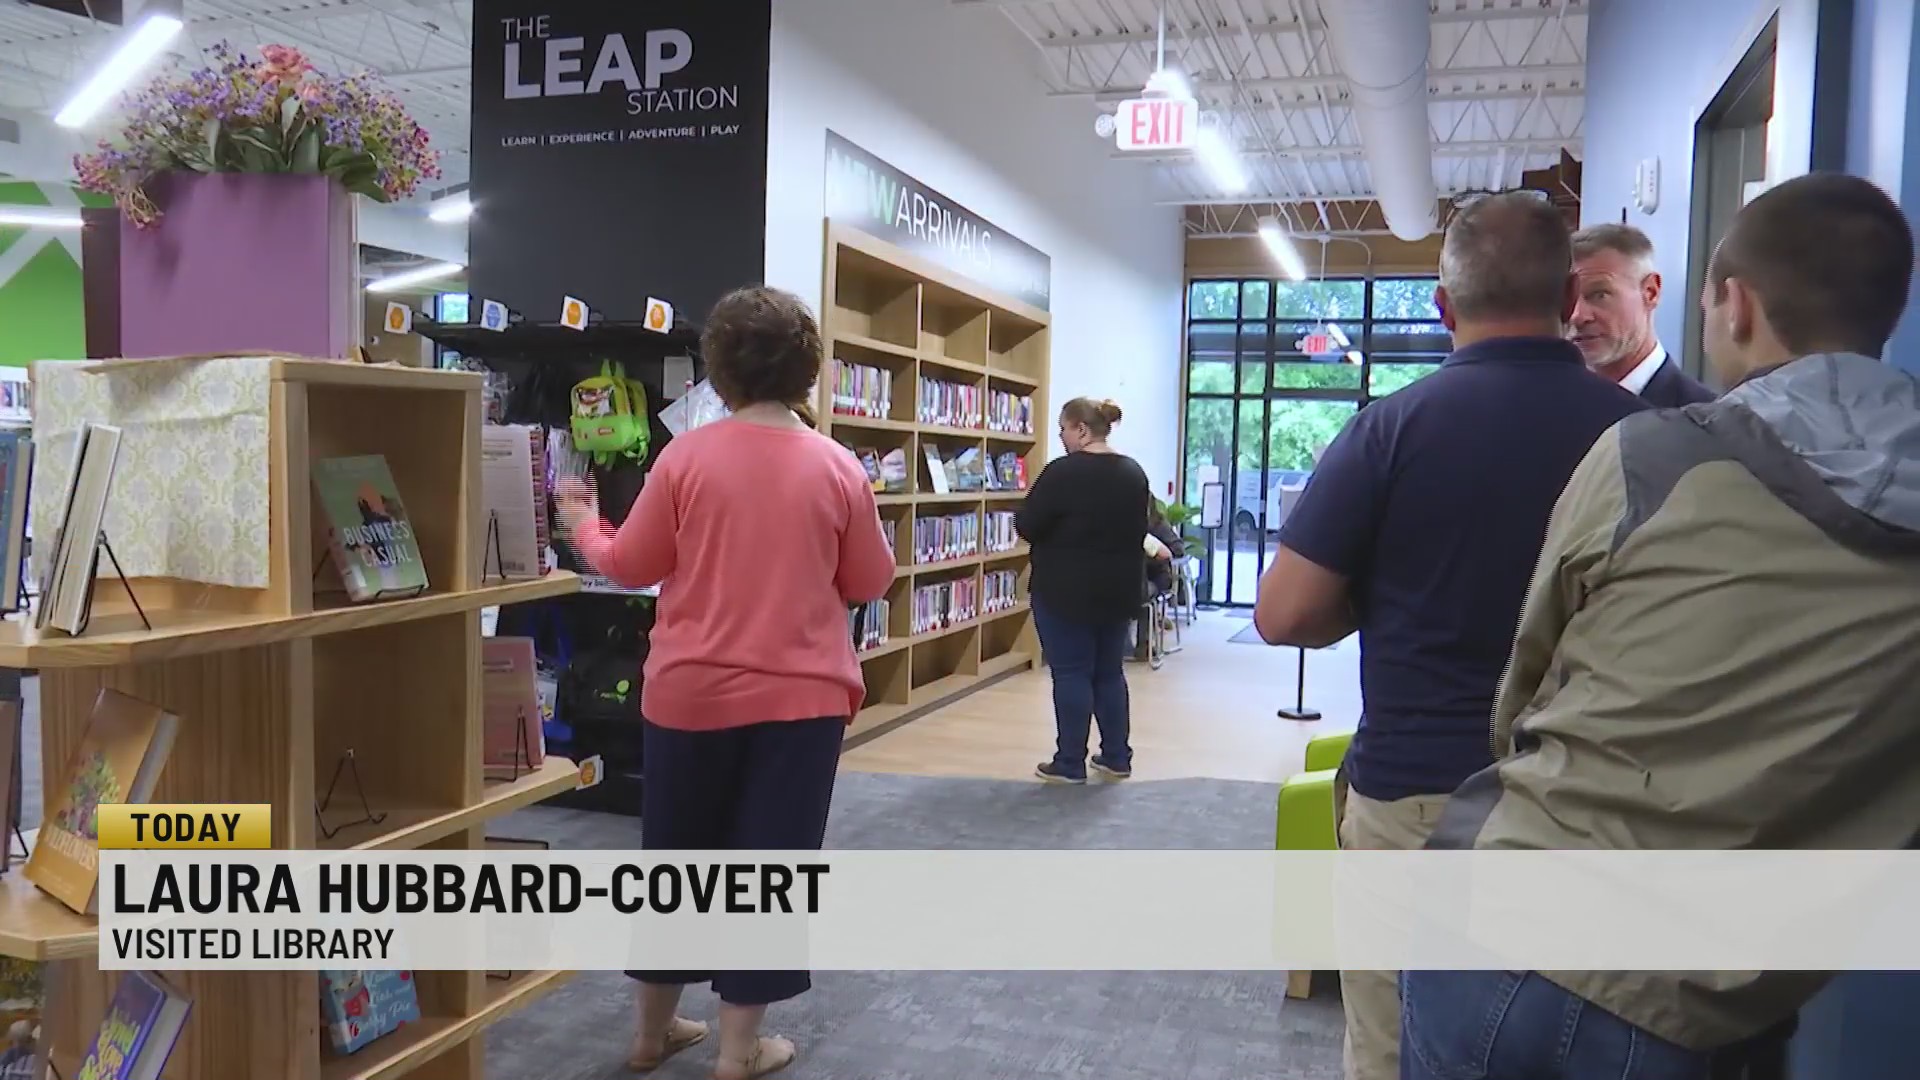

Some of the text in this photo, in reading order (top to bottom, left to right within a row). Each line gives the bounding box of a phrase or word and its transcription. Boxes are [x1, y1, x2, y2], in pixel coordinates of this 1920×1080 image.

[500, 14, 551, 41] THE
[503, 28, 693, 99] LEAP
[626, 85, 739, 115] STATION
[501, 124, 741, 147] LEARN EXPERIENCE ADVENTURE PLAY
[1131, 102, 1187, 144] EXIT
[895, 186, 992, 269] ARRIVALS
[343, 520, 410, 546] BUSINESS
[360, 543, 412, 568] CASUAL
